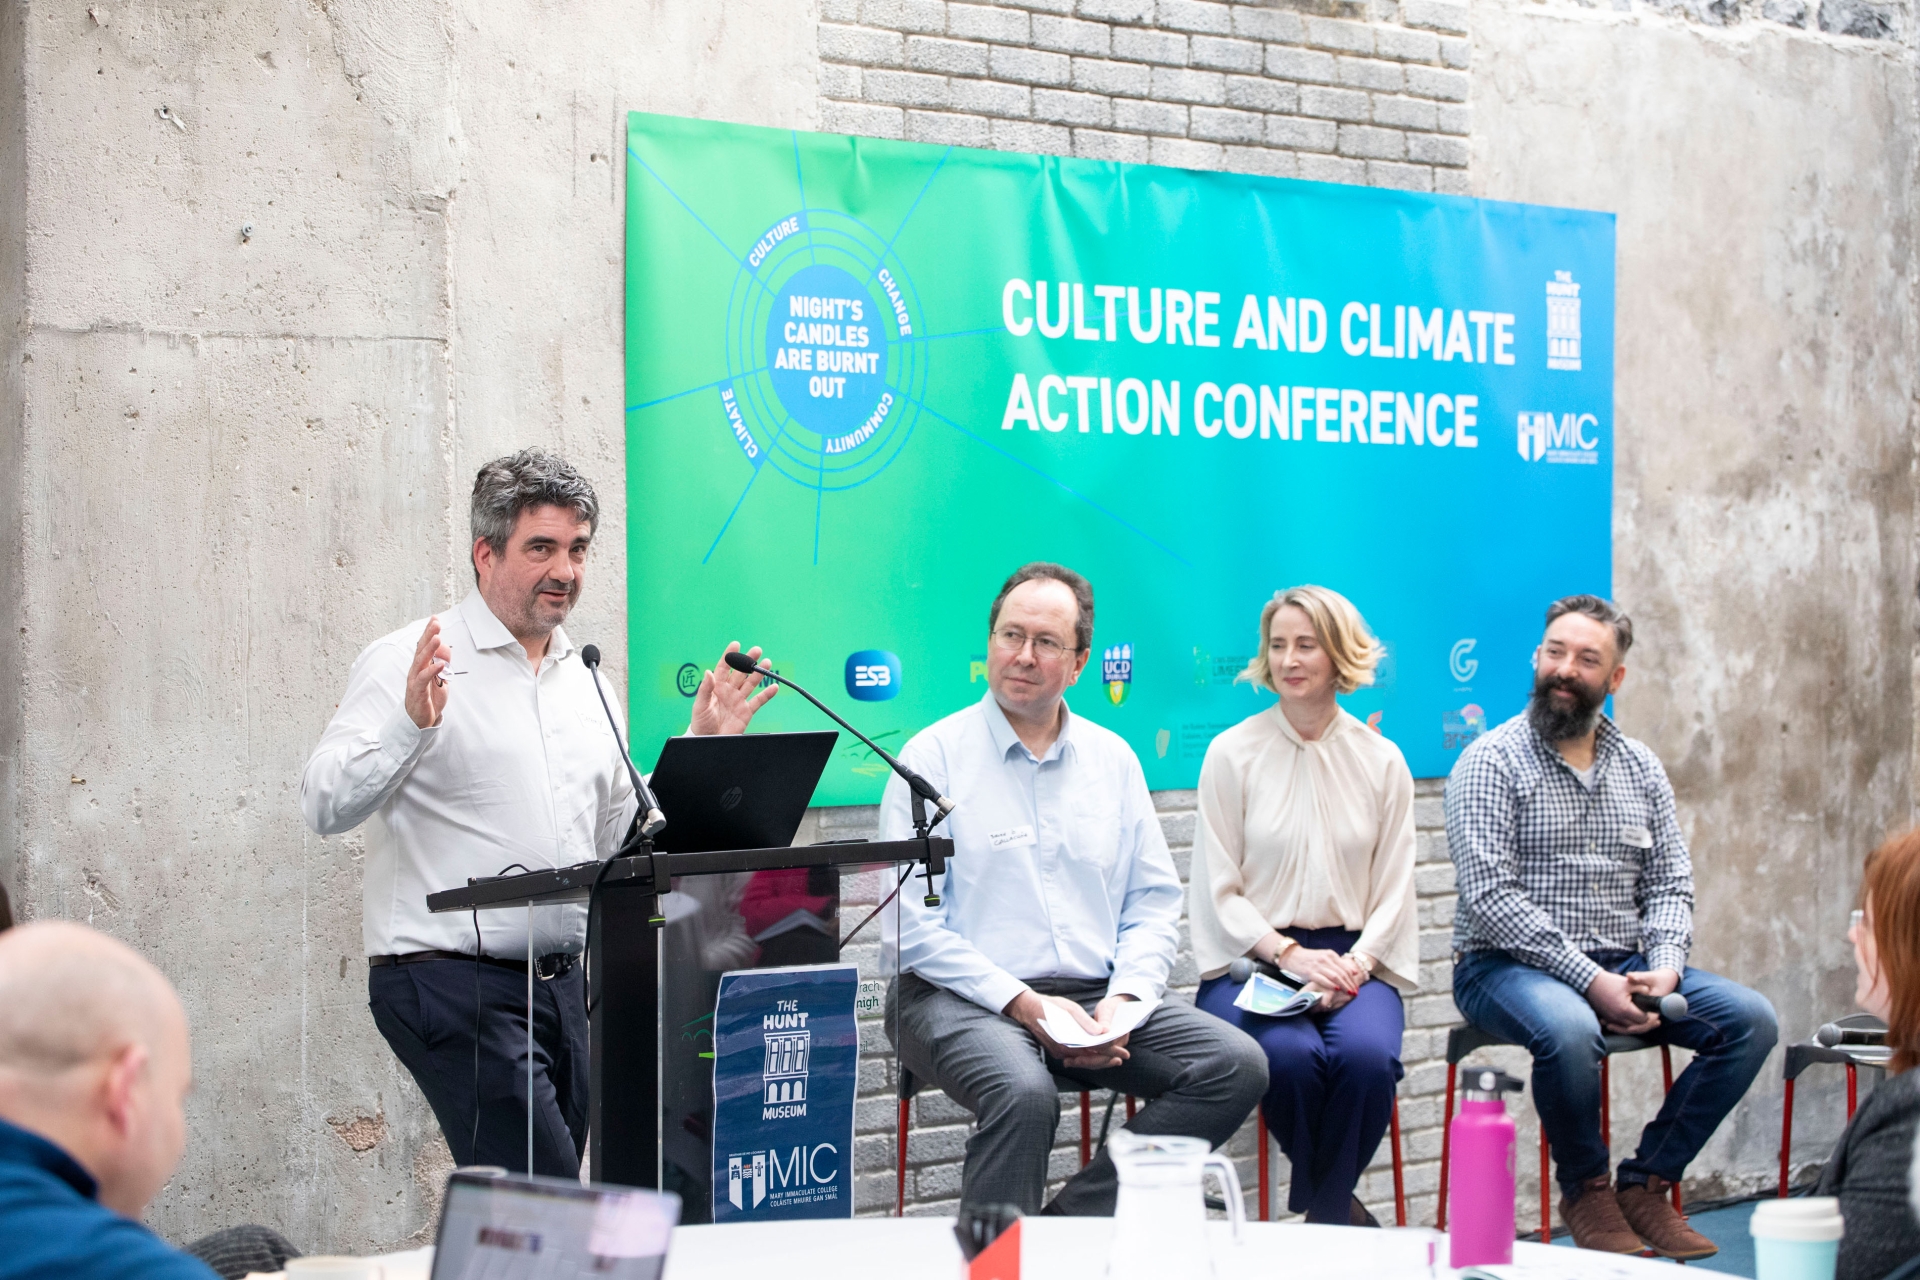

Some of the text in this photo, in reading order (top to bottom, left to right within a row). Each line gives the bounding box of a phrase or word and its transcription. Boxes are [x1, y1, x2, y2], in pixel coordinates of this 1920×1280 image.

[749, 216, 800, 267] CULTURE
[789, 295, 864, 321] NIGHT'S
[878, 268, 912, 336] CHANGE
[784, 321, 869, 348] CANDLES
[1002, 278, 1516, 365] CULTURE AND CLIMATE
[774, 347, 880, 375] ARE BURNT
[809, 376, 846, 399] OUT
[721, 388, 759, 458] CLIMATE
[825, 392, 893, 453] COMMUNITY
[1001, 373, 1479, 448] ACTION CONFERENCE
[1546, 411, 1599, 450] MIC
[855, 665, 891, 687] ESB
[1104, 661, 1131, 674] UCD
[776, 999, 799, 1012] THE
[763, 1012, 809, 1030] HUNT
[762, 1103, 807, 1121] MUSEUM
[769, 1143, 838, 1189] MIC
[769, 1185, 838, 1200] MARY IMMACULATE COLLEGE
[812, 1194, 824, 1202] GAN
